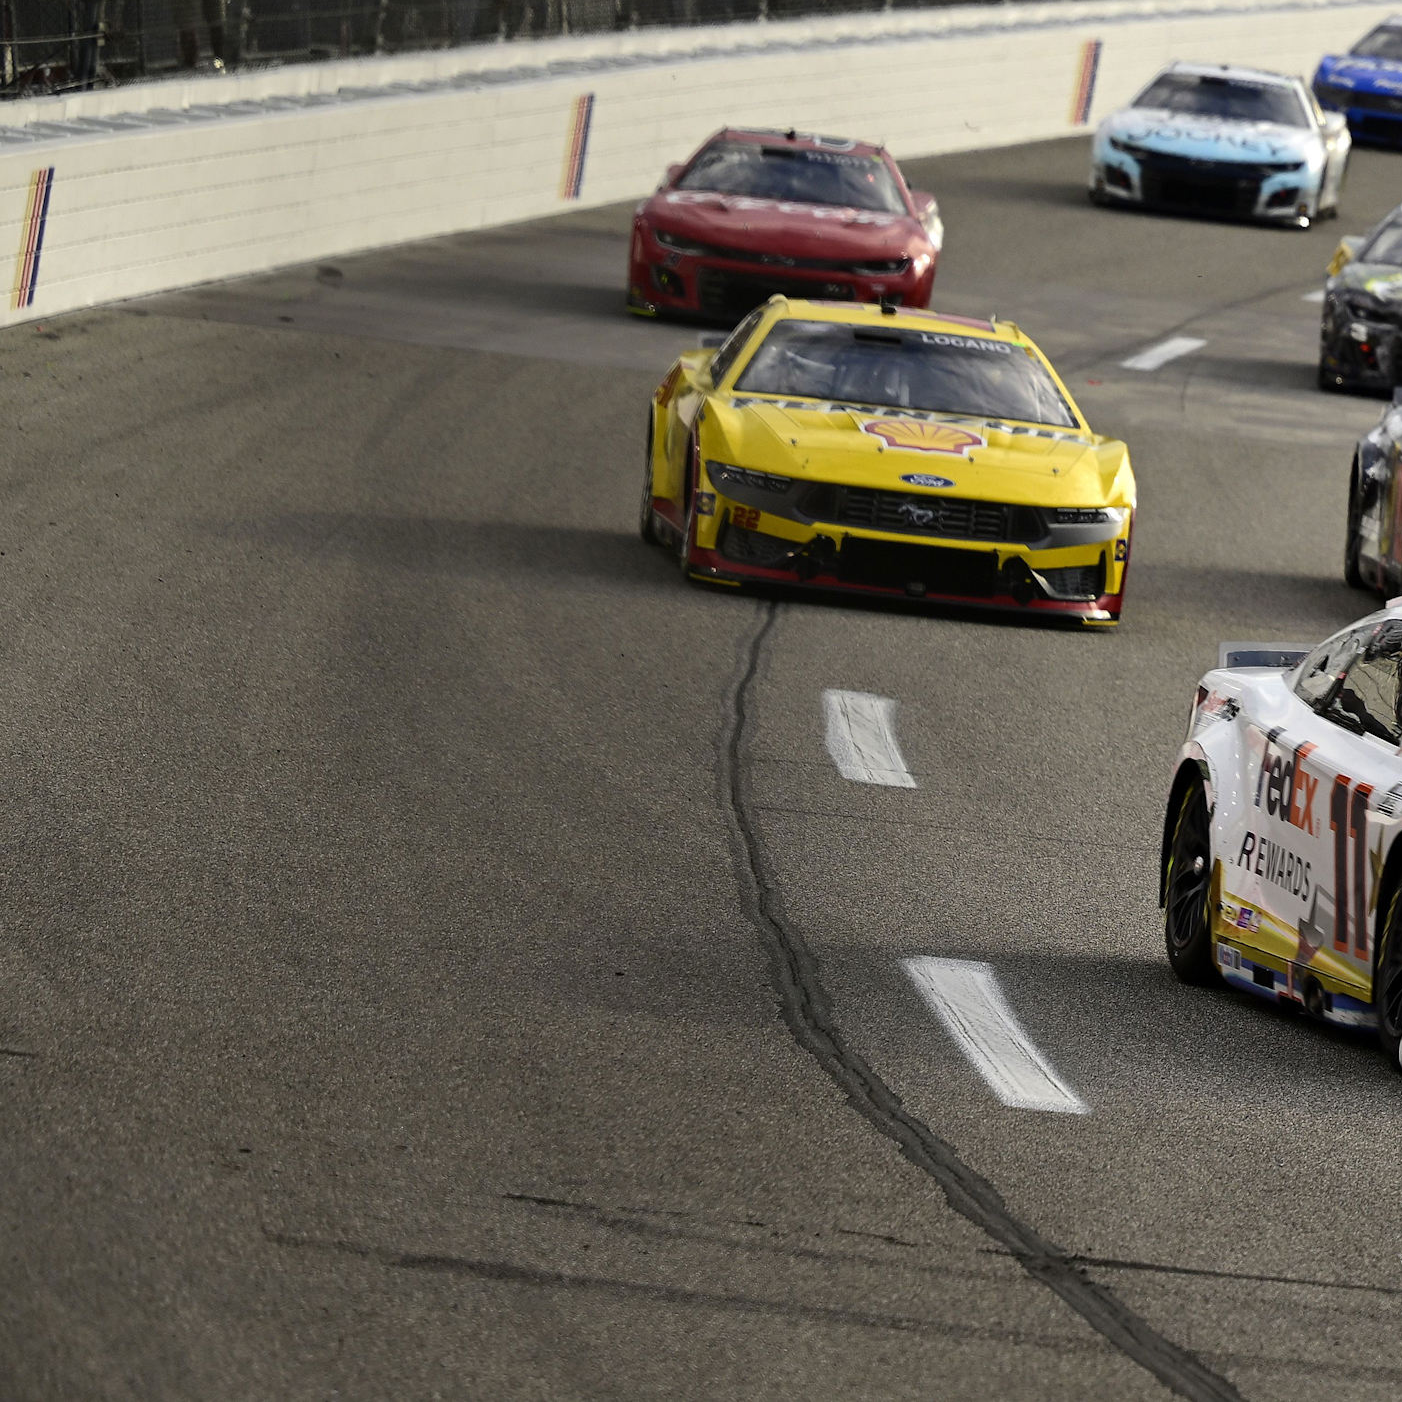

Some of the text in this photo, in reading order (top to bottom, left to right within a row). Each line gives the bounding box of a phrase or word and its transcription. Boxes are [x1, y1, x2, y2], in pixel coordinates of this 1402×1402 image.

[921, 332, 1012, 355] LOGANO
[732, 505, 762, 530] 22
[1237, 830, 1312, 903] REWARDS
[1329, 773, 1375, 962] 11
